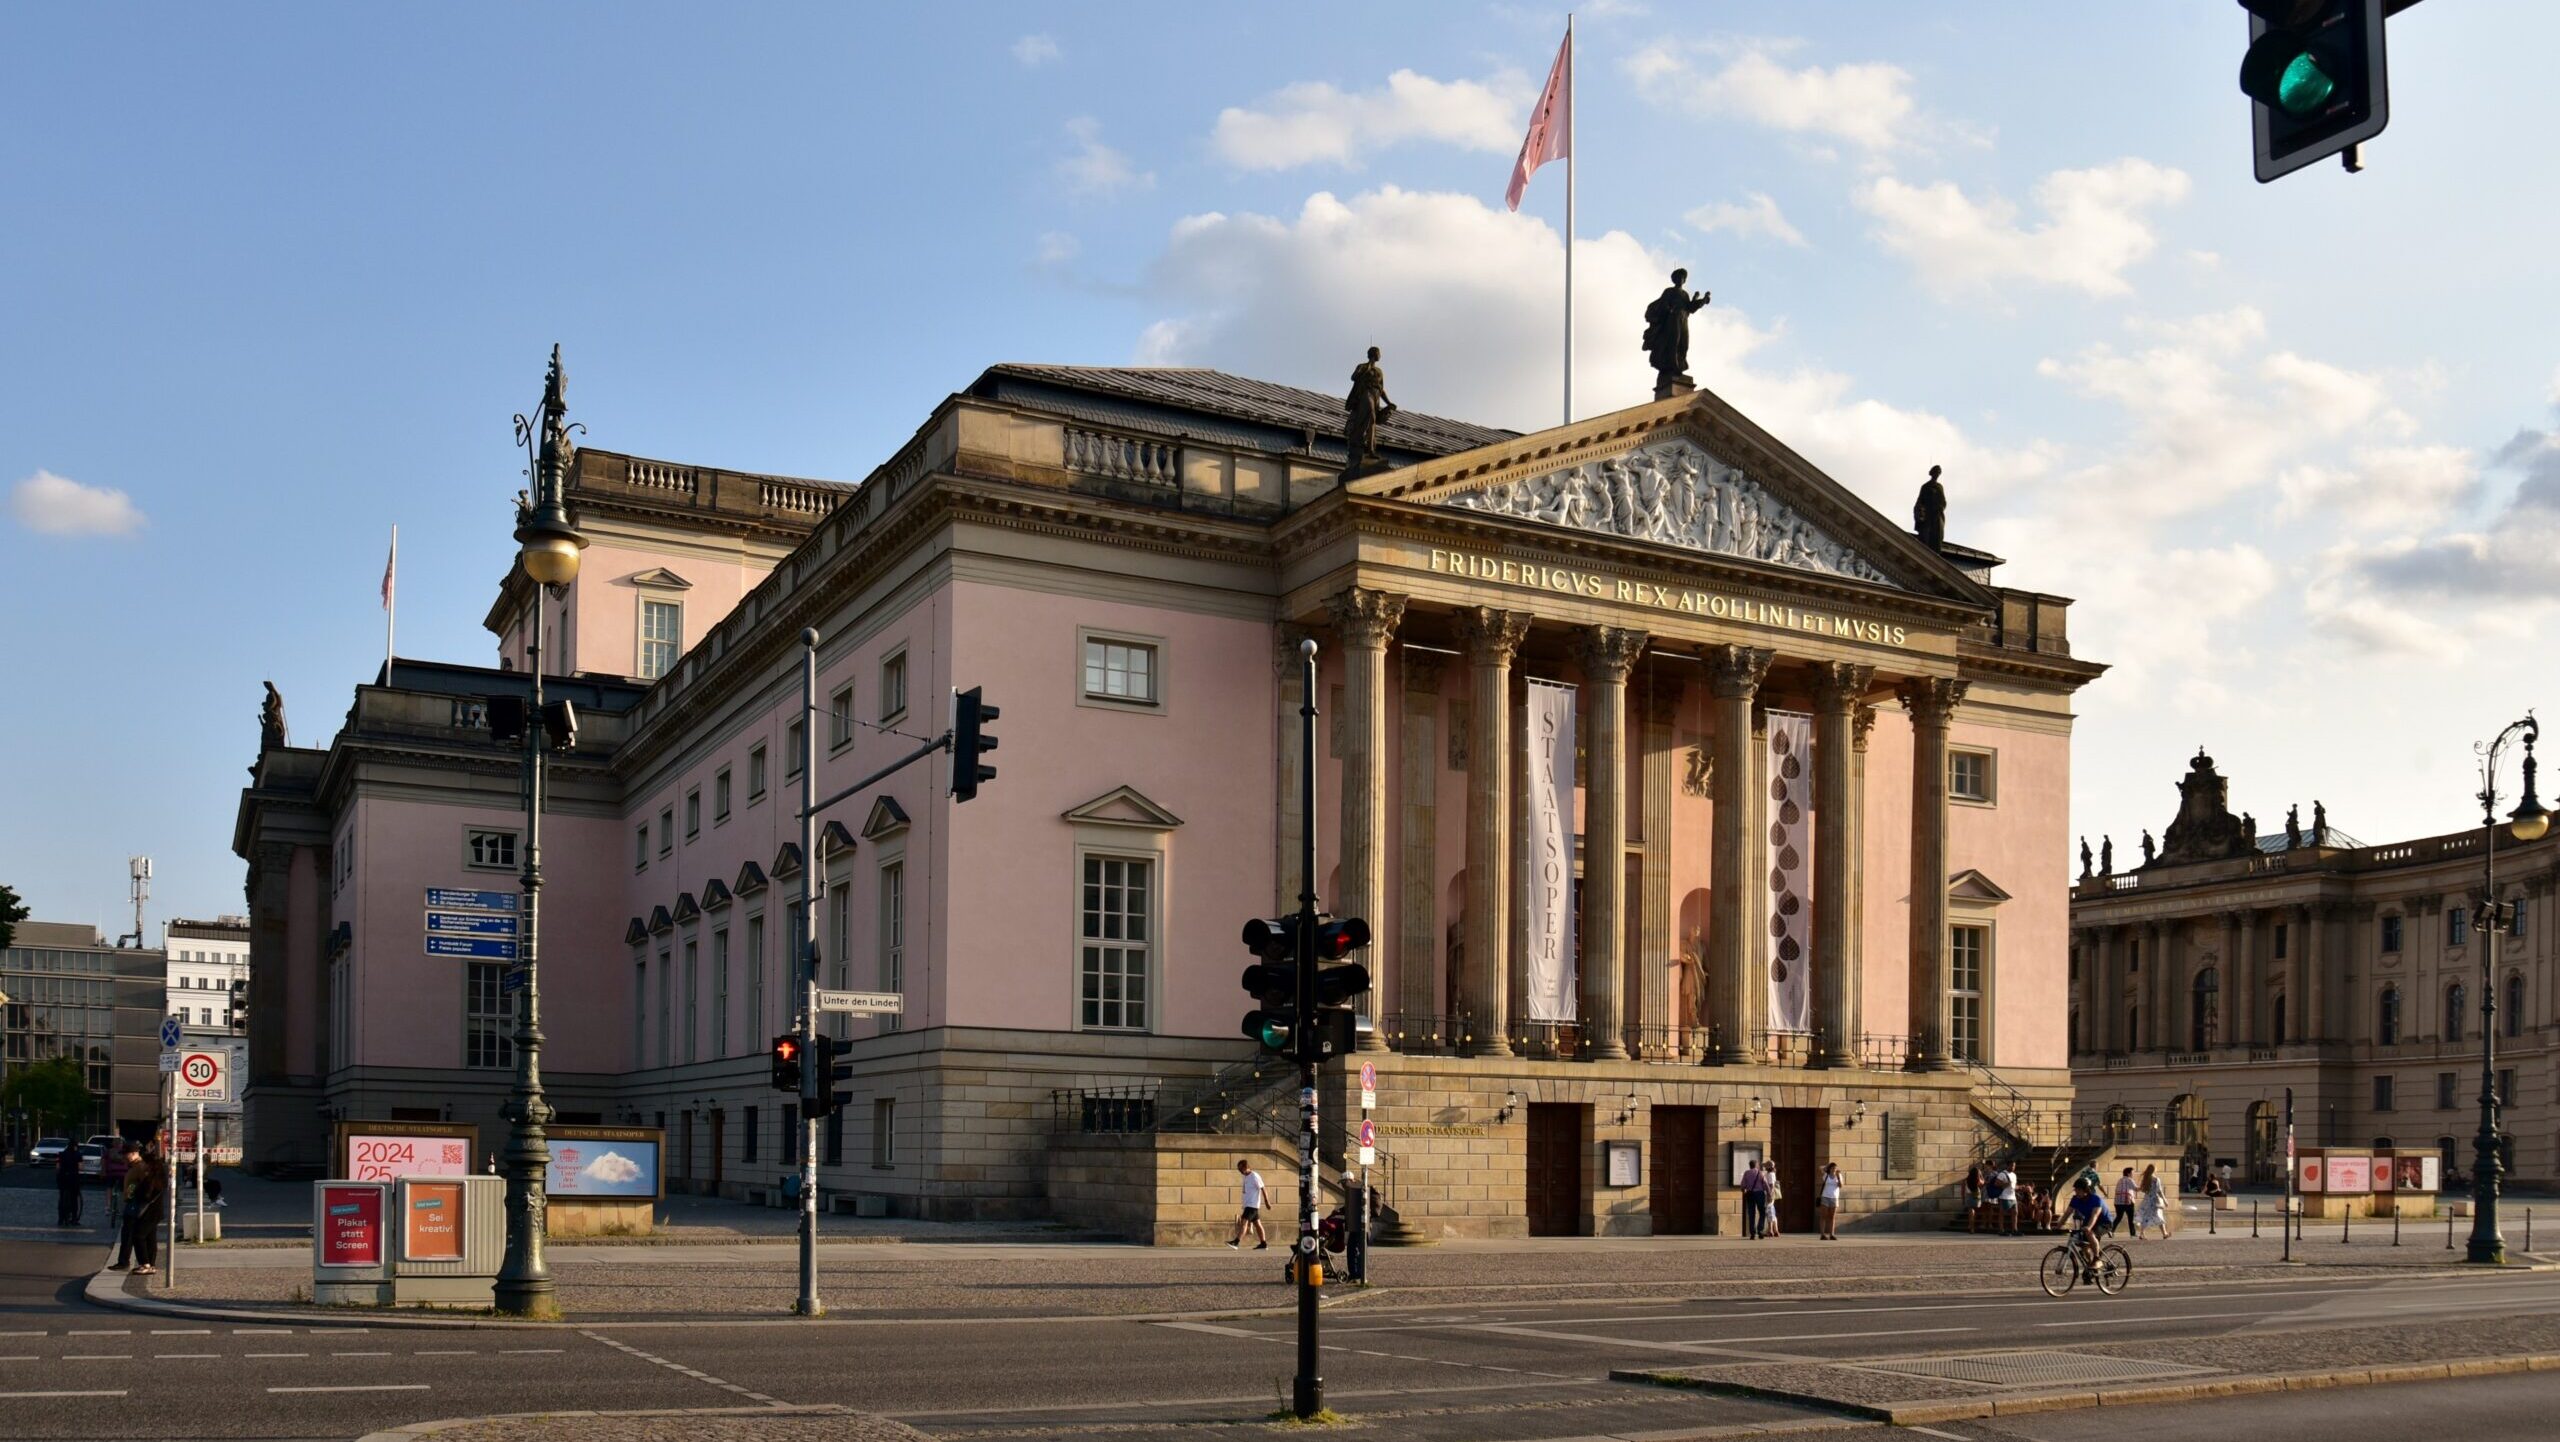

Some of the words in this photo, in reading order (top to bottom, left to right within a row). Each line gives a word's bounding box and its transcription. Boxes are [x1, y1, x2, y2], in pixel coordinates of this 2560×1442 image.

[1431, 549, 1602, 595] FRIDERICVS
[1617, 580, 1669, 606] REX
[1678, 591, 1794, 627] APOLLINI
[1834, 617, 1906, 645] MVSIS
[1541, 711, 1560, 960] STAATSOPER
[824, 996, 849, 1004] Unter
[851, 998, 868, 1006] den
[870, 998, 899, 1007] Linden
[189, 1063, 210, 1078] 30
[1375, 1125, 1427, 1136] DEUTSCHE
[1427, 1125, 1485, 1136] STAATSOPER
[357, 1142, 415, 1163] 2024
[337, 1218, 368, 1227] Plakat
[428, 1213, 443, 1222] Sei
[340, 1230, 364, 1238] statt
[419, 1224, 454, 1233] kreativ!
[336, 1241, 369, 1249] Screen
